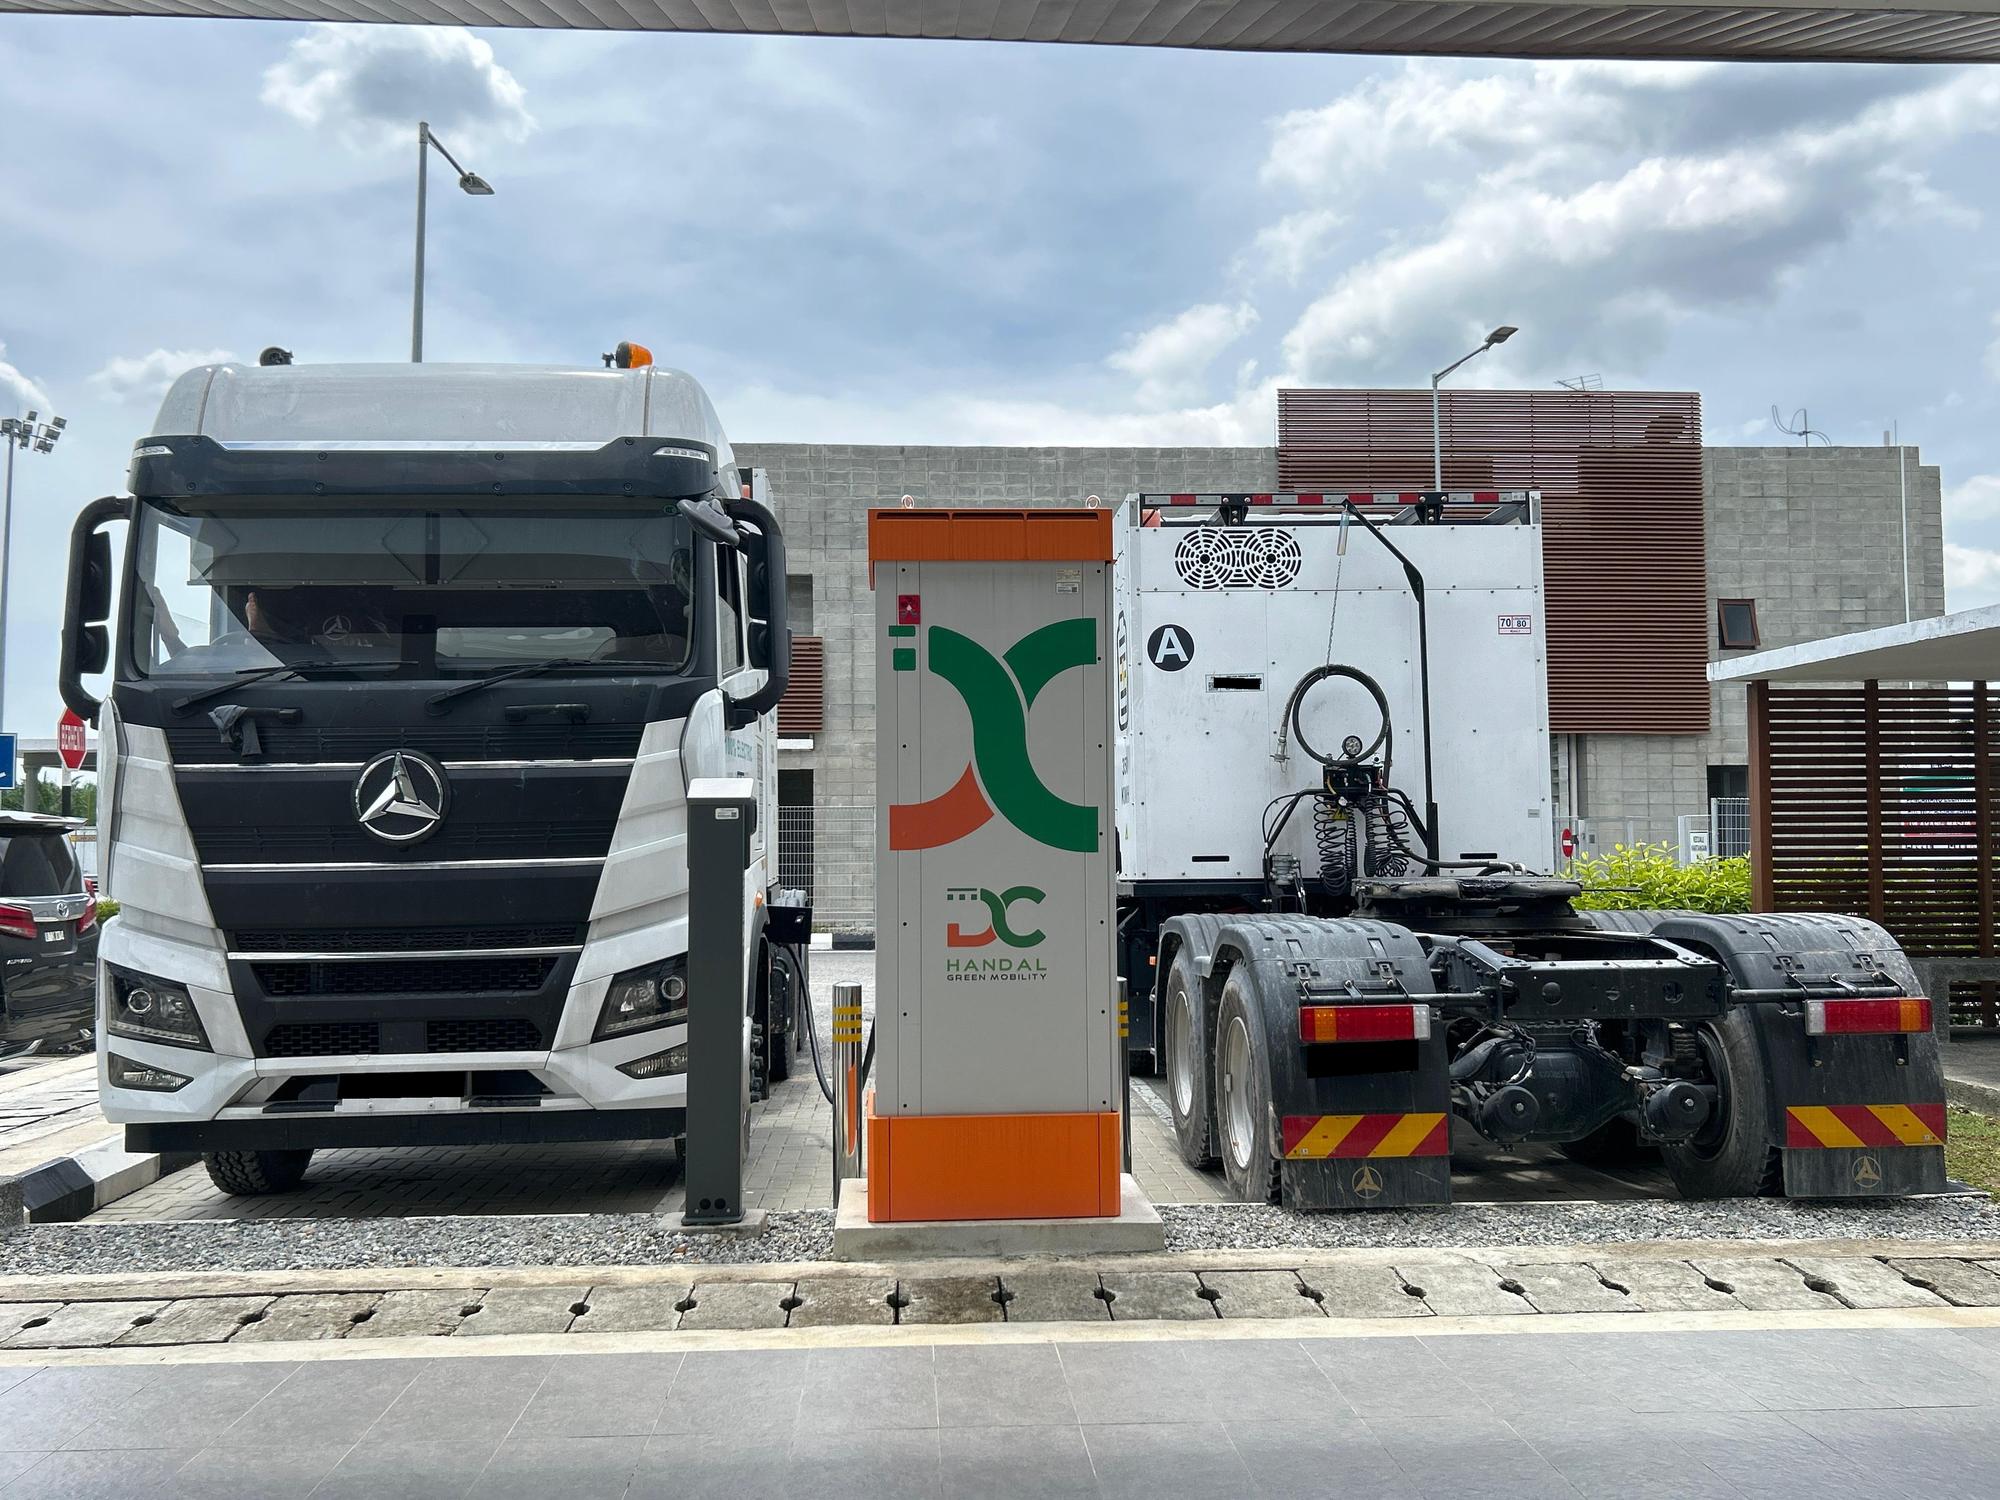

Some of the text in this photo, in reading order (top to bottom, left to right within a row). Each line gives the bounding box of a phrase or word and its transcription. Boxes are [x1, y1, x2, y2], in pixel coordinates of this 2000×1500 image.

[1500, 618, 1511, 627] 70
[1154, 628, 1189, 663] A
[946, 959, 1048, 972] HANDAL
[990, 973, 1048, 981] MOBILITY
